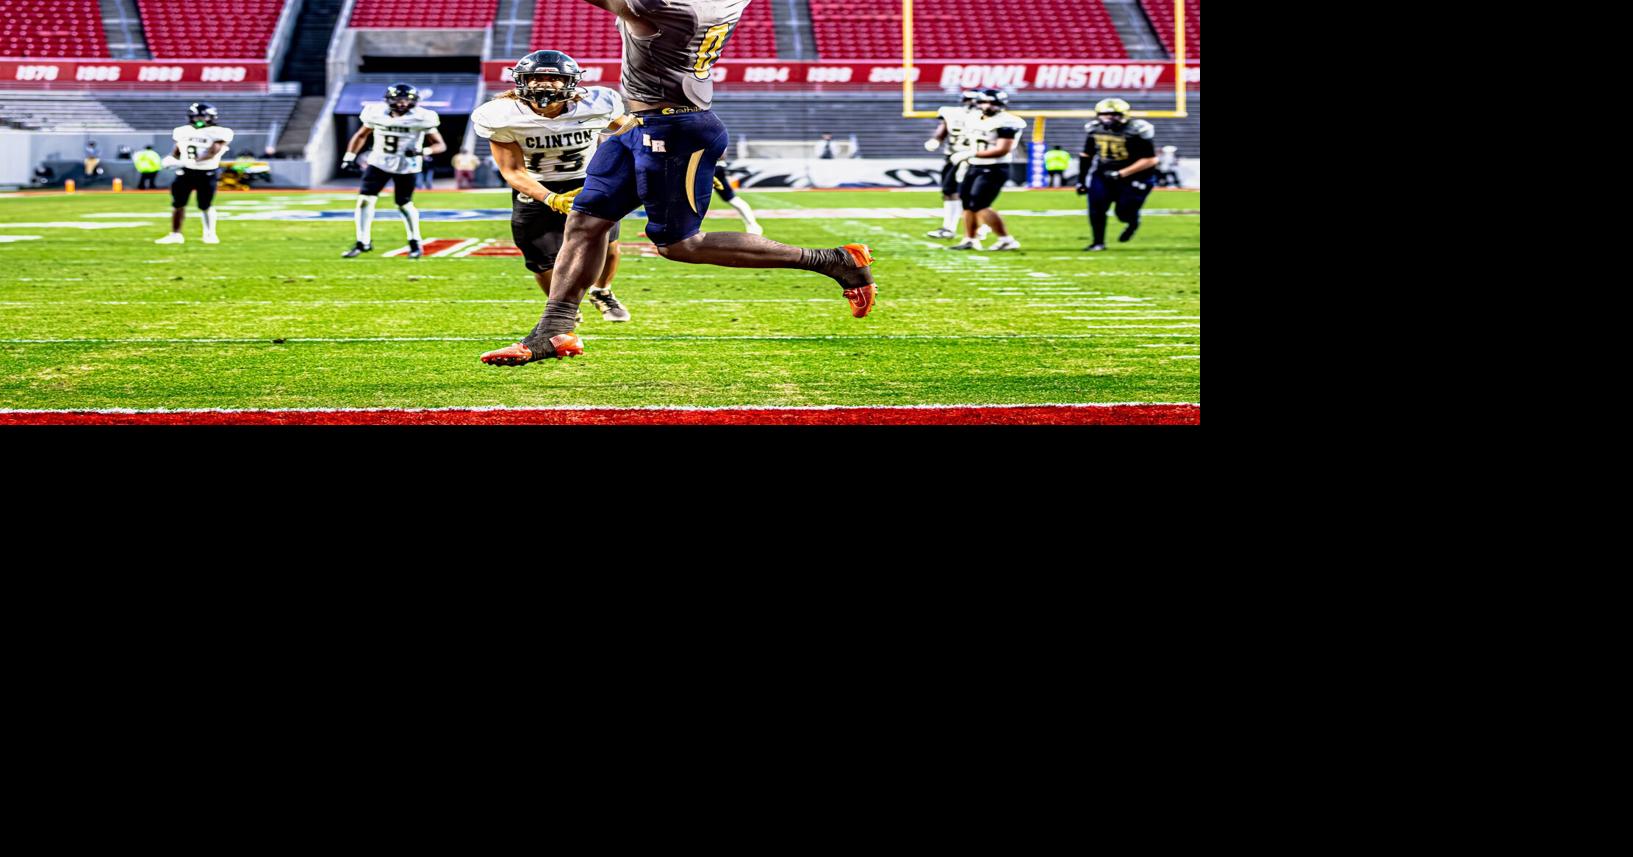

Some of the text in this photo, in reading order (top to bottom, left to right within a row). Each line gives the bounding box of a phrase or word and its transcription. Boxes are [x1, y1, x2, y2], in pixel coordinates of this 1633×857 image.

[16, 65, 59, 81] 1978
[744, 67, 790, 82] 1994
[940, 65, 1027, 89] BOWL
[1035, 65, 1163, 88] HISTORY
[383, 135, 399, 154] 9
[525, 129, 593, 149] CLINTON
[527, 145, 590, 173] 15
